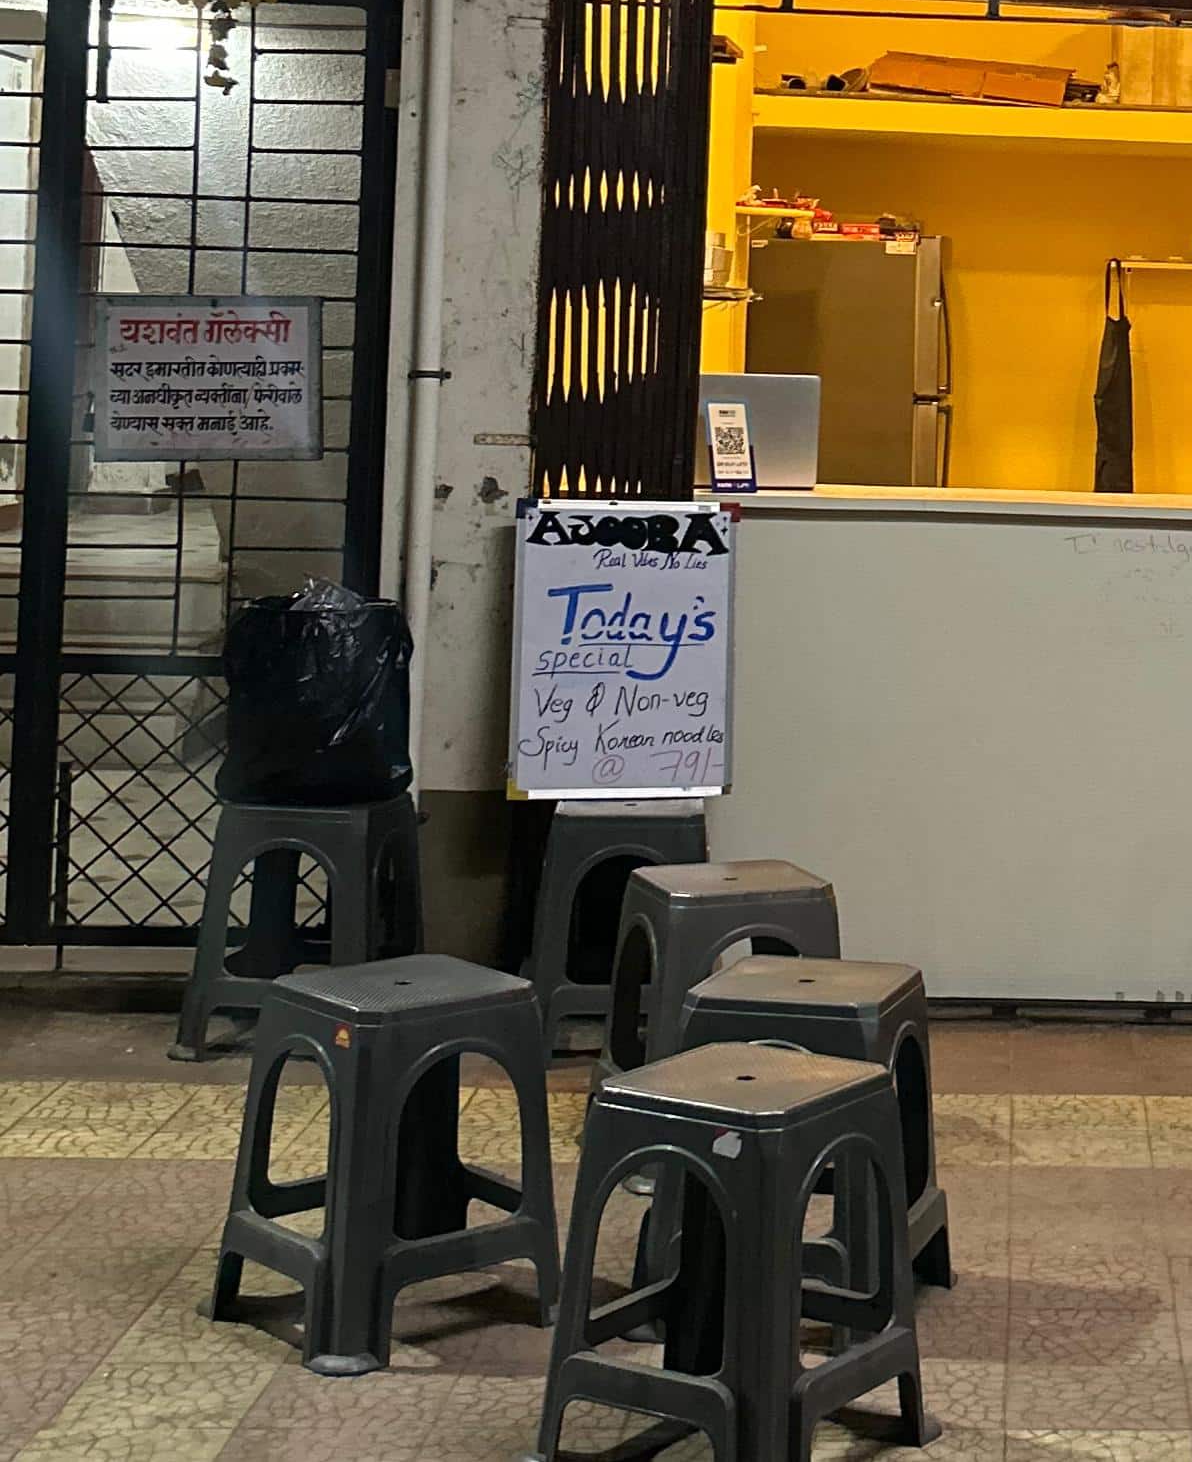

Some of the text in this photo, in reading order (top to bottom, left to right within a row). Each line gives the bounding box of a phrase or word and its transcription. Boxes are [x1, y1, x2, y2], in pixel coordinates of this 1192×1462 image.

[120, 313, 200, 345] यशवंत
[526, 511, 730, 556] AJOOBA
[594, 548, 626, 571] Real
[660, 551, 681, 571] No
[684, 554, 709, 570] Lies
[547, 584, 716, 680] Today's
[535, 644, 633, 679] special
[534, 684, 573, 723] Veg
[614, 684, 709, 717] Non-veg
[517, 719, 724, 770] Spicy Korean noodles
[591, 754, 625, 785] @
